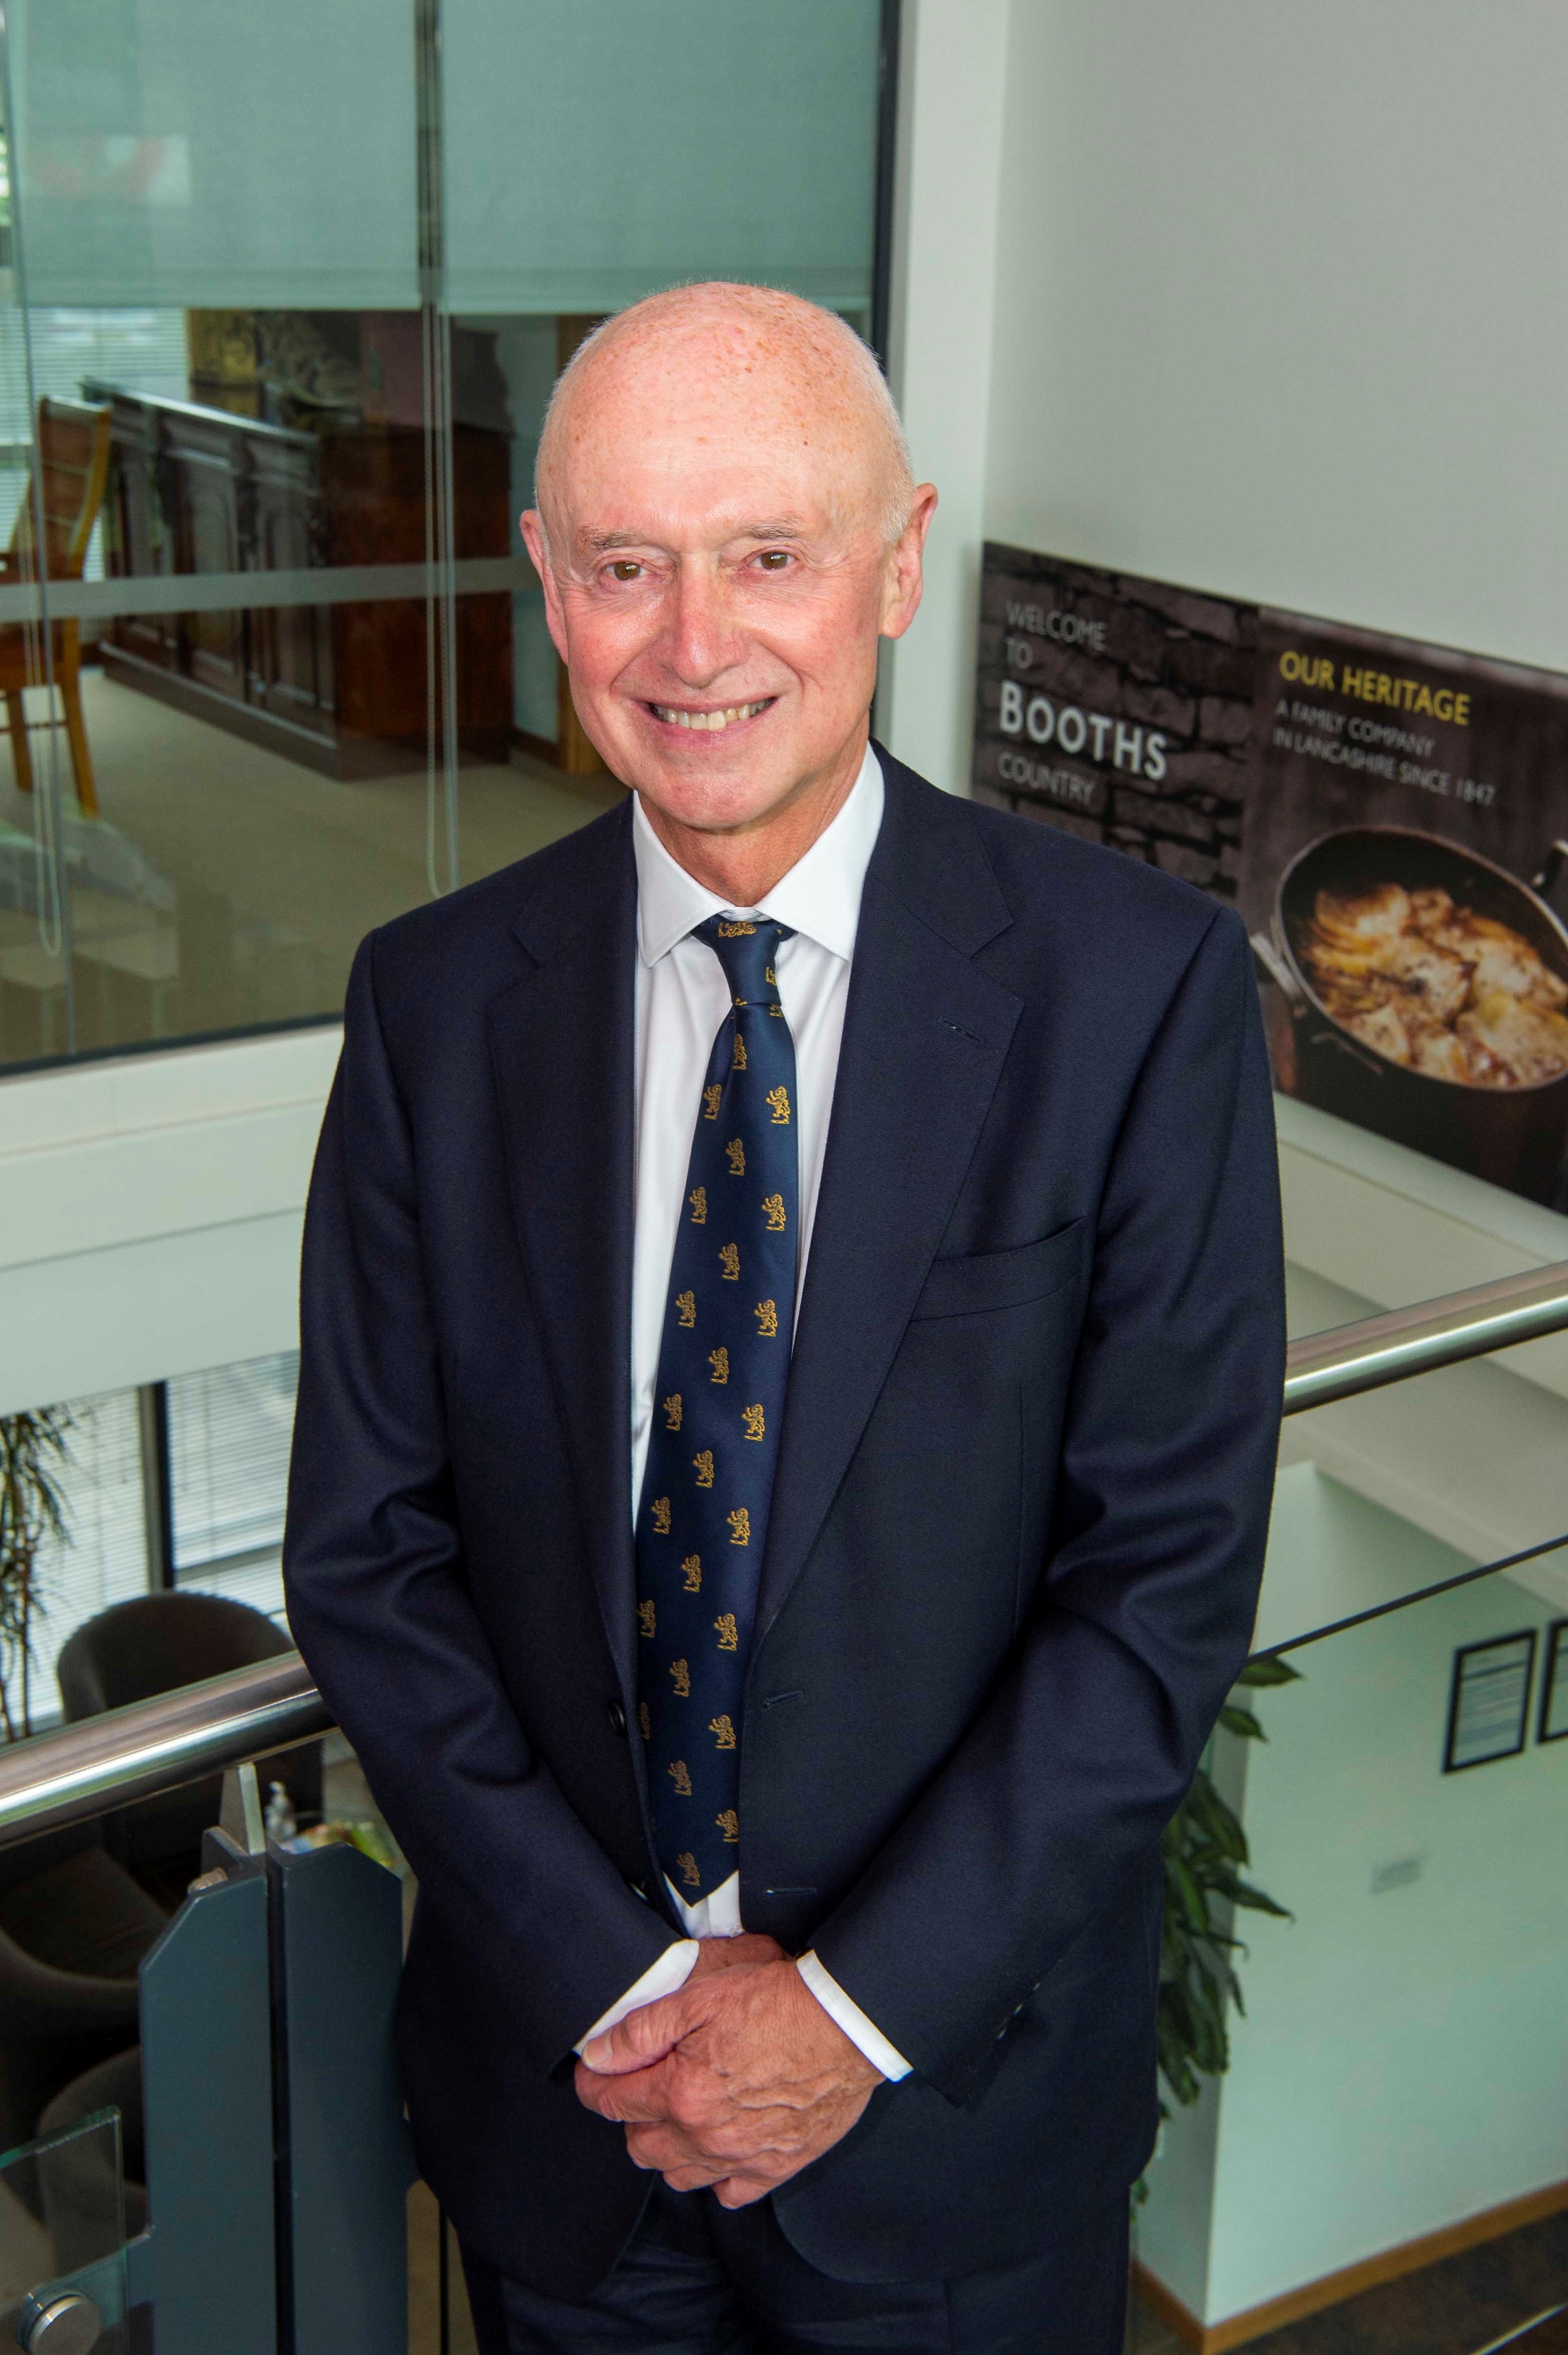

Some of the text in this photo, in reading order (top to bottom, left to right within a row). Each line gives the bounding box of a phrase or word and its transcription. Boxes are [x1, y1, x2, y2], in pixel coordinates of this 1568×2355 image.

[1005, 636, 1033, 669] TO
[1006, 600, 1106, 651] WELCOME
[1279, 651, 1471, 726] OUR HERITAGE
[1000, 680, 1167, 780] BOOTHS
[1276, 699, 1436, 759] A FAMILY COMPANY
[998, 752, 1096, 806] COUNTRY
[1273, 727, 1294, 749] IN
[1294, 733, 1397, 781] LANCASHIRE
[1399, 760, 1450, 796] SINCE
